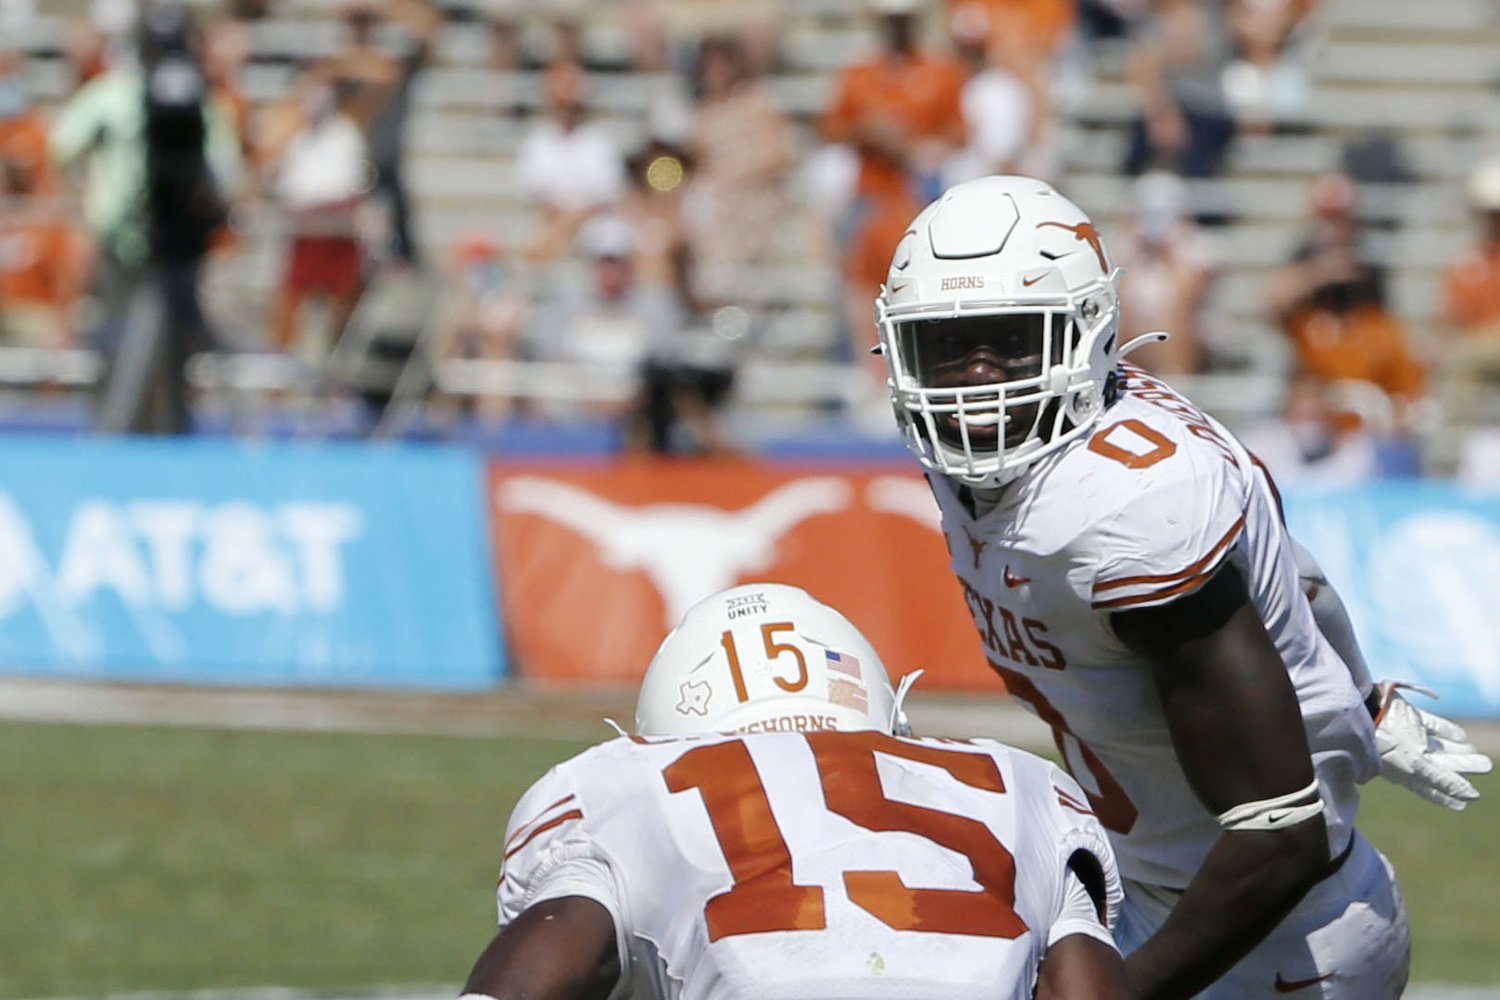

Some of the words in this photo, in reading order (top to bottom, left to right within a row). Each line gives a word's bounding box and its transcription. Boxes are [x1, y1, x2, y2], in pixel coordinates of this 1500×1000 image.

[941, 276, 985, 292] HORNS
[58, 498, 362, 612] AT&T
[728, 604, 768, 620] UNITY
[720, 621, 808, 703] 15
[661, 730, 1030, 943] 15
